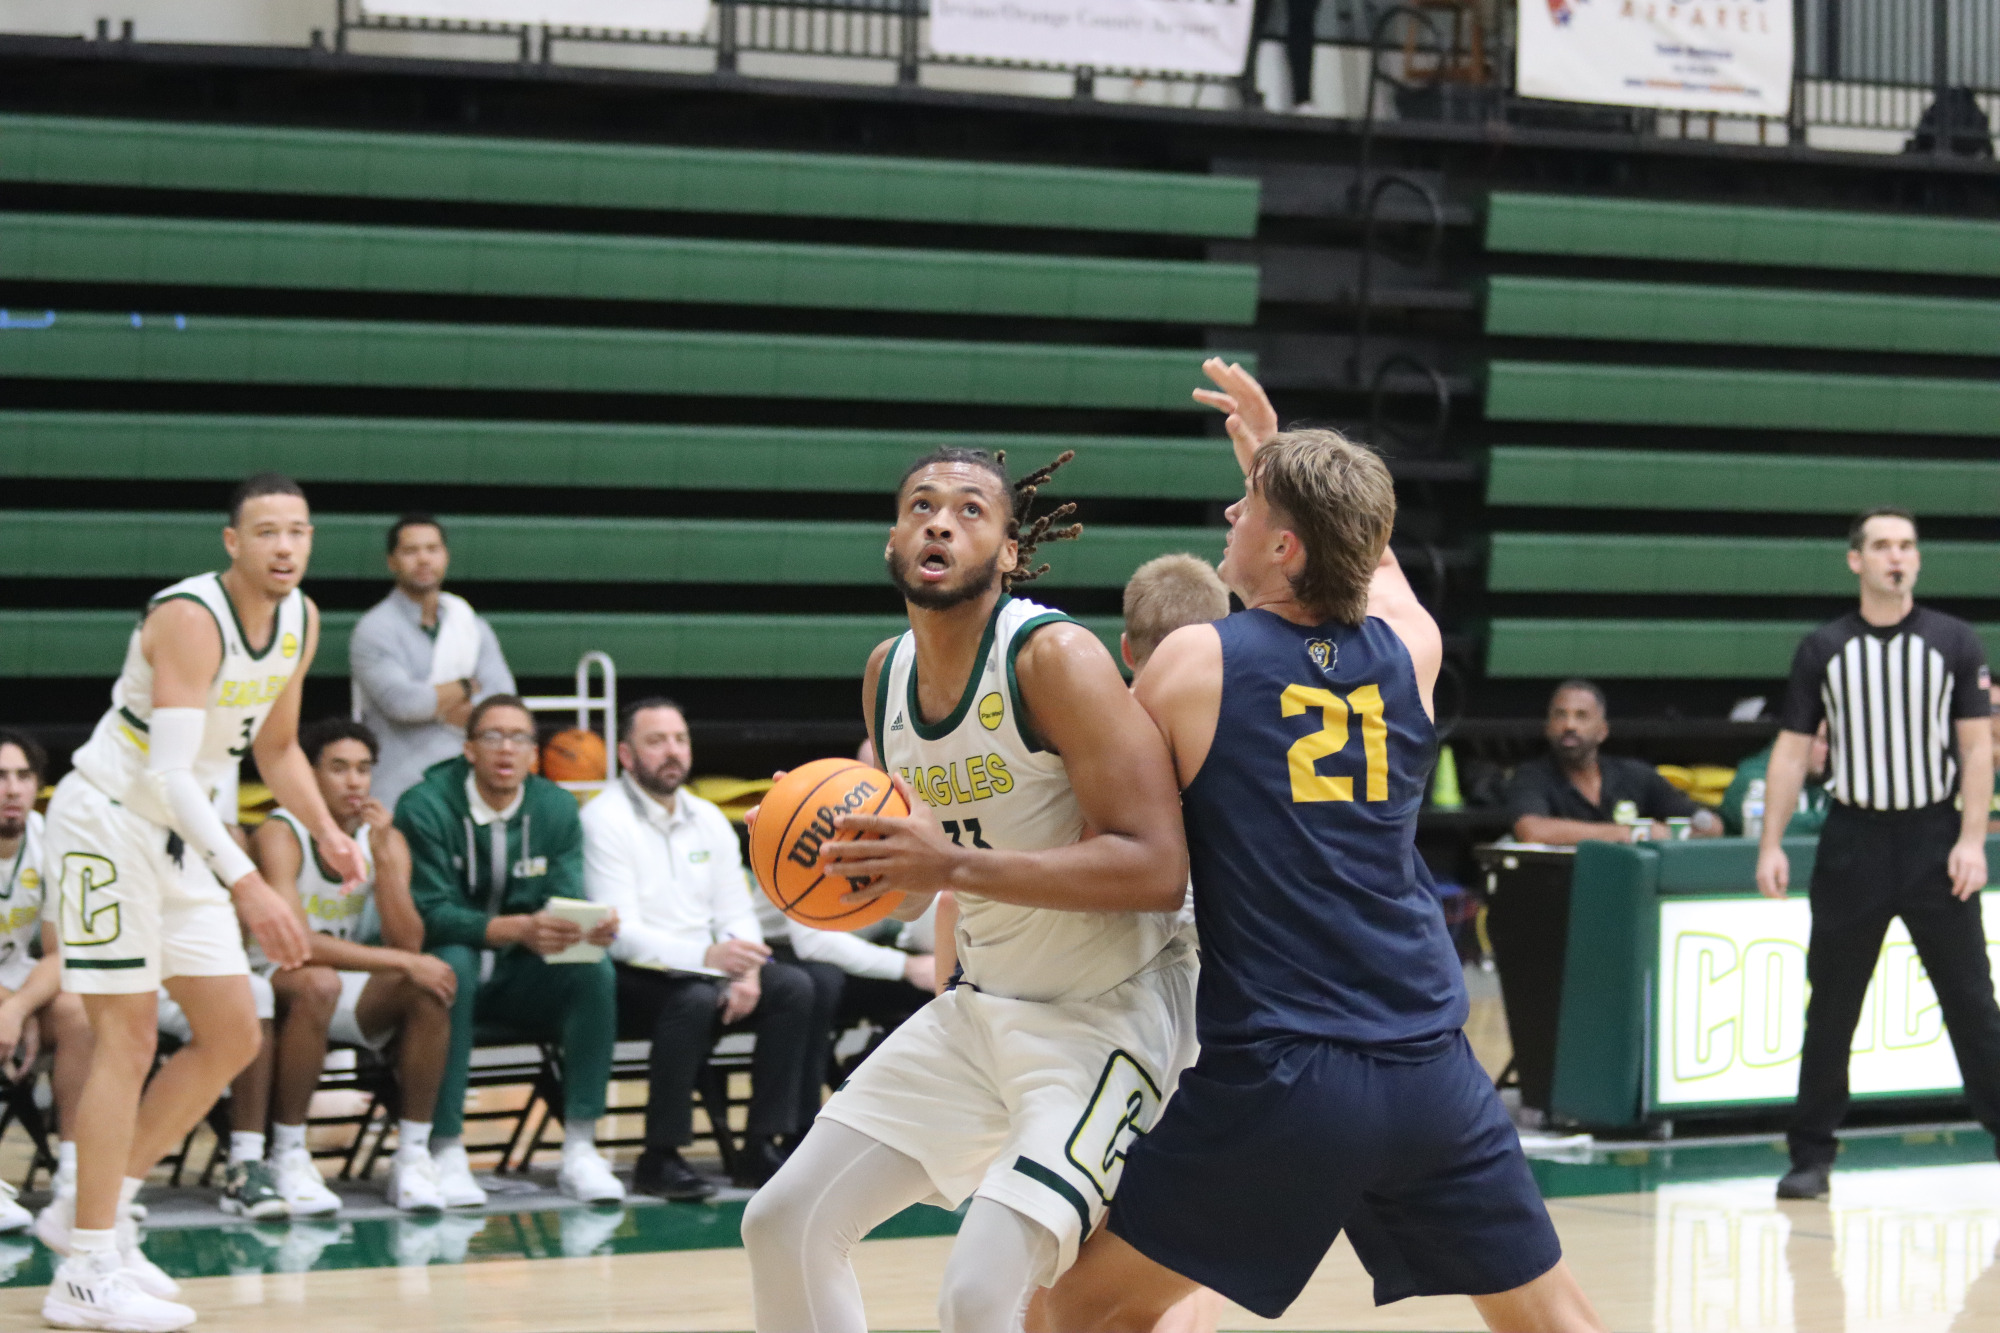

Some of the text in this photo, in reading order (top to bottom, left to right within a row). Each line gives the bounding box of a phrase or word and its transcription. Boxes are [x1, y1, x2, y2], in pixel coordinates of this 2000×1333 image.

[1280, 683, 1388, 803] 21
[787, 780, 879, 869] Wilson
[61, 851, 121, 946] C
